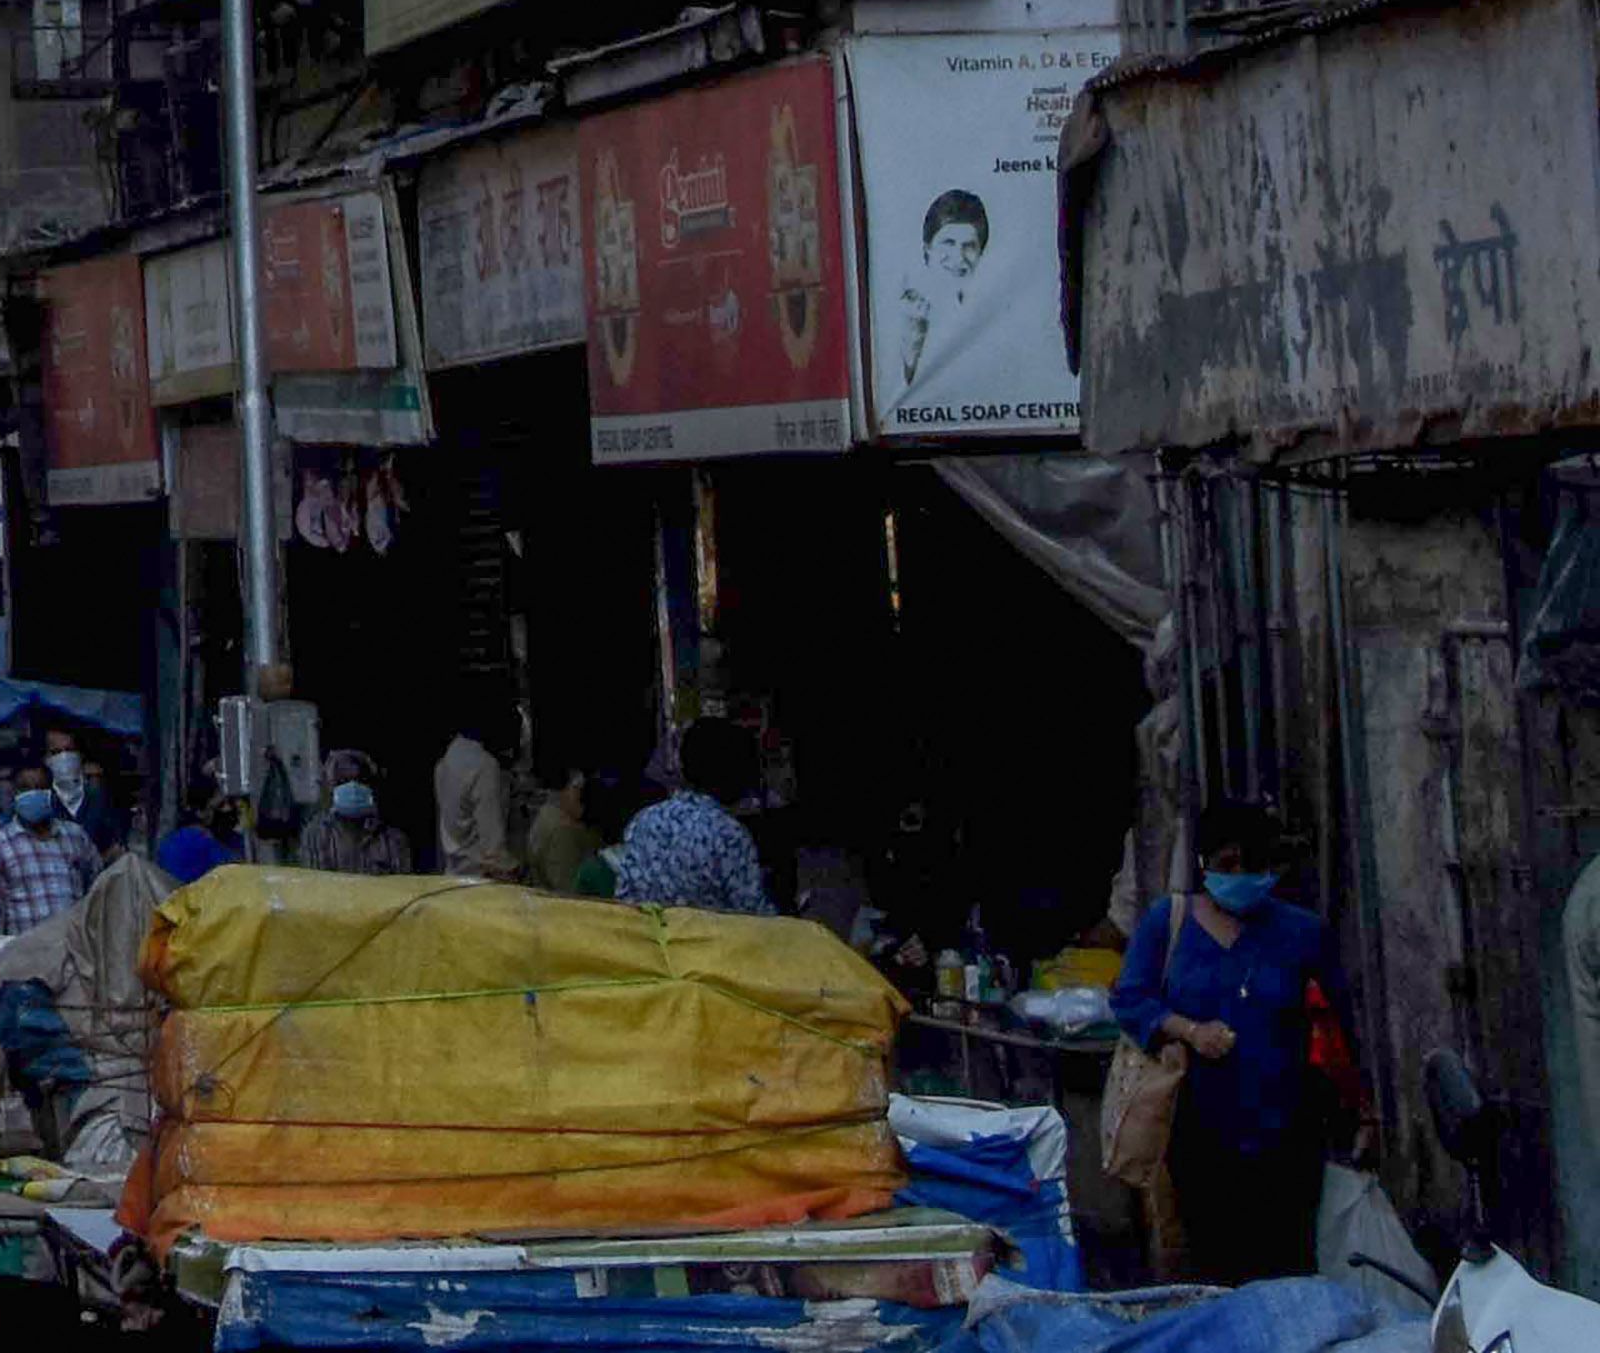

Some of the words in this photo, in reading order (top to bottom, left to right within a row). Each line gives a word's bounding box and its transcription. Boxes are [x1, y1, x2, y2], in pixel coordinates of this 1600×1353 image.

[946, 54, 1013, 72] Vitamin
[1018, 55, 1036, 70] A,
[1040, 52, 1054, 67] D
[1059, 51, 1072, 68] &
[1076, 52, 1087, 67] E
[992, 157, 1042, 173] Jeene
[896, 407, 957, 424] REGAL
[961, 404, 1011, 421] SOAP
